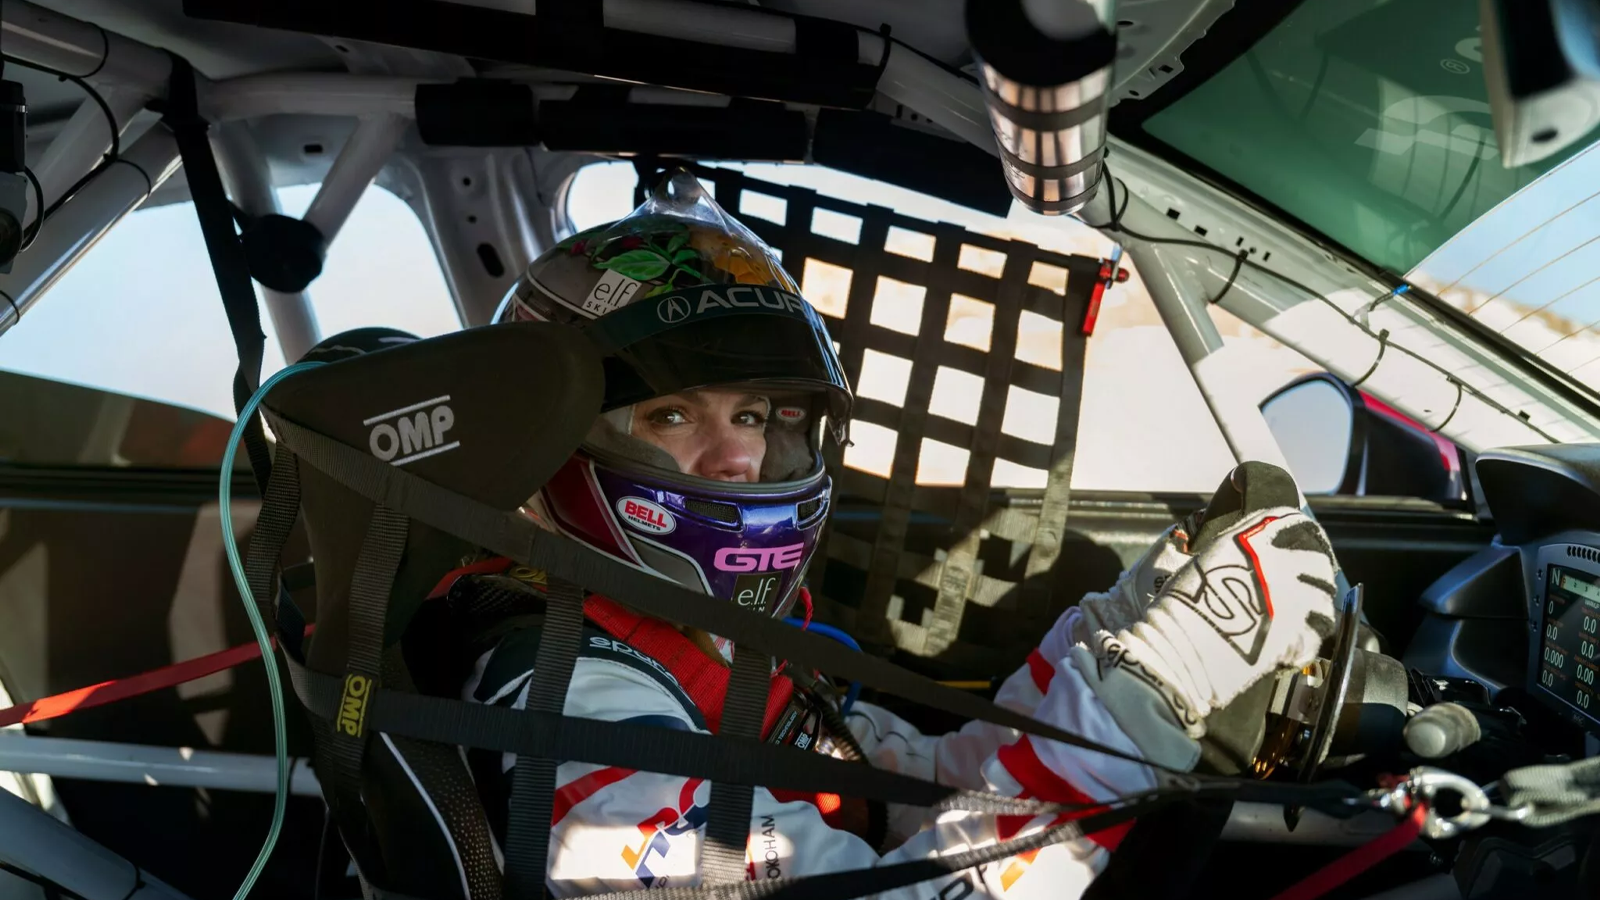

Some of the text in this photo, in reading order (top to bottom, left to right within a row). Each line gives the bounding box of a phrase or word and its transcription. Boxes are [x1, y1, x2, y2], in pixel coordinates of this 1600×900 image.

[586, 300, 614, 314] SKI
[369, 405, 455, 462] OMP
[625, 500, 667, 528] BELL
[628, 515, 661, 531] HELMETS
[1551, 567, 1561, 586] N
[1546, 623, 1558, 641] 0.0
[1583, 616, 1597, 634] 0.0
[1544, 646, 1564, 668] 0.000
[1581, 640, 1594, 659] 0.0
[1542, 669, 1553, 687] 0.0
[1576, 664, 1594, 685] 0.00
[340, 675, 366, 736] OMP
[1576, 690, 1589, 709] 0.0
[796, 733, 810, 749] OMP
